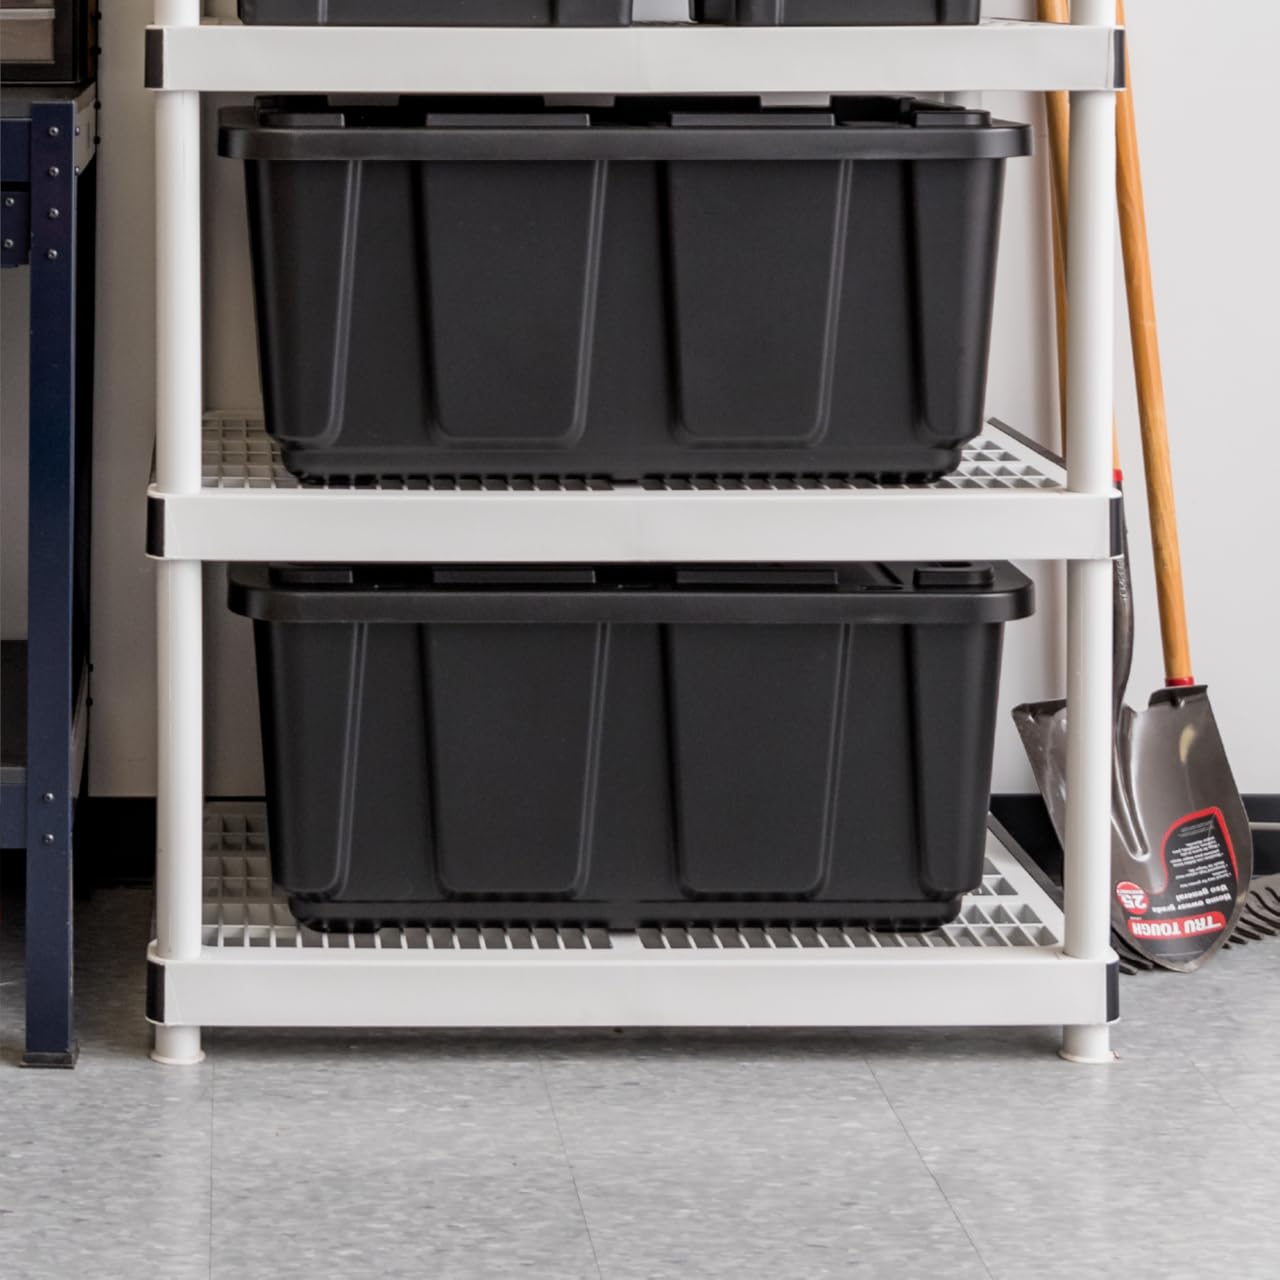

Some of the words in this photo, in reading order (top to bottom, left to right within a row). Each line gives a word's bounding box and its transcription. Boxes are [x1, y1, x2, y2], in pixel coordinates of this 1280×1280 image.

[1121, 895, 1147, 909] 25
[1131, 922, 1181, 936] TOUGH
[1184, 916, 1222, 933] TRU
